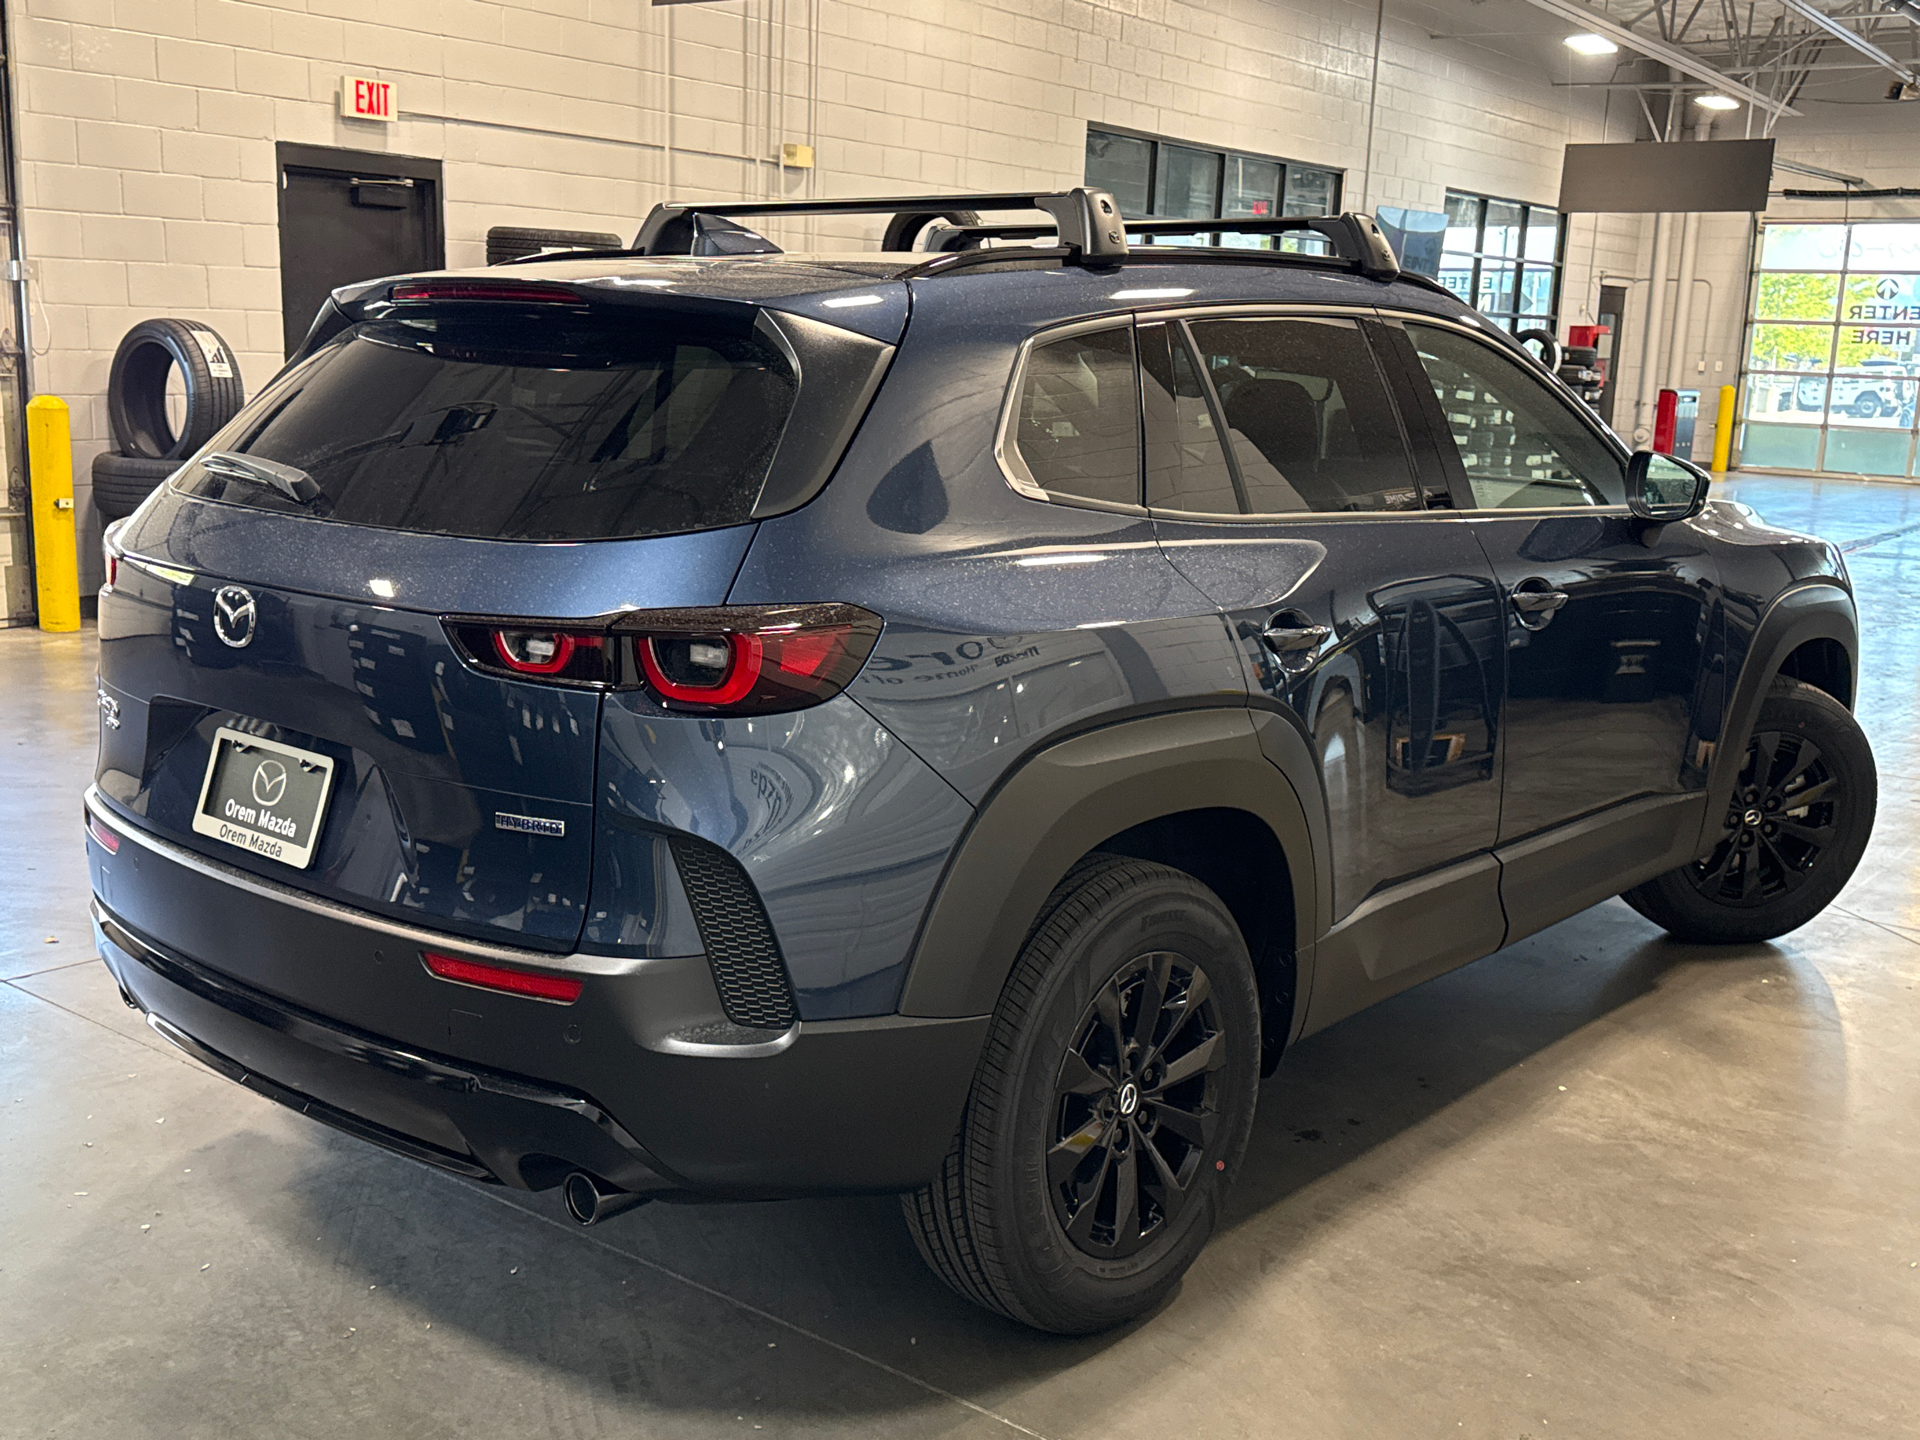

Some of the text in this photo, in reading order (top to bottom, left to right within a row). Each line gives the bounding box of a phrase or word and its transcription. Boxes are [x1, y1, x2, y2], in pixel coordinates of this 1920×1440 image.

[355, 79, 390, 117] EXIT
[225, 798, 297, 838] Orem Mazda
[500, 815, 559, 834] HYBRID
[219, 824, 283, 858] Orem Mazda
